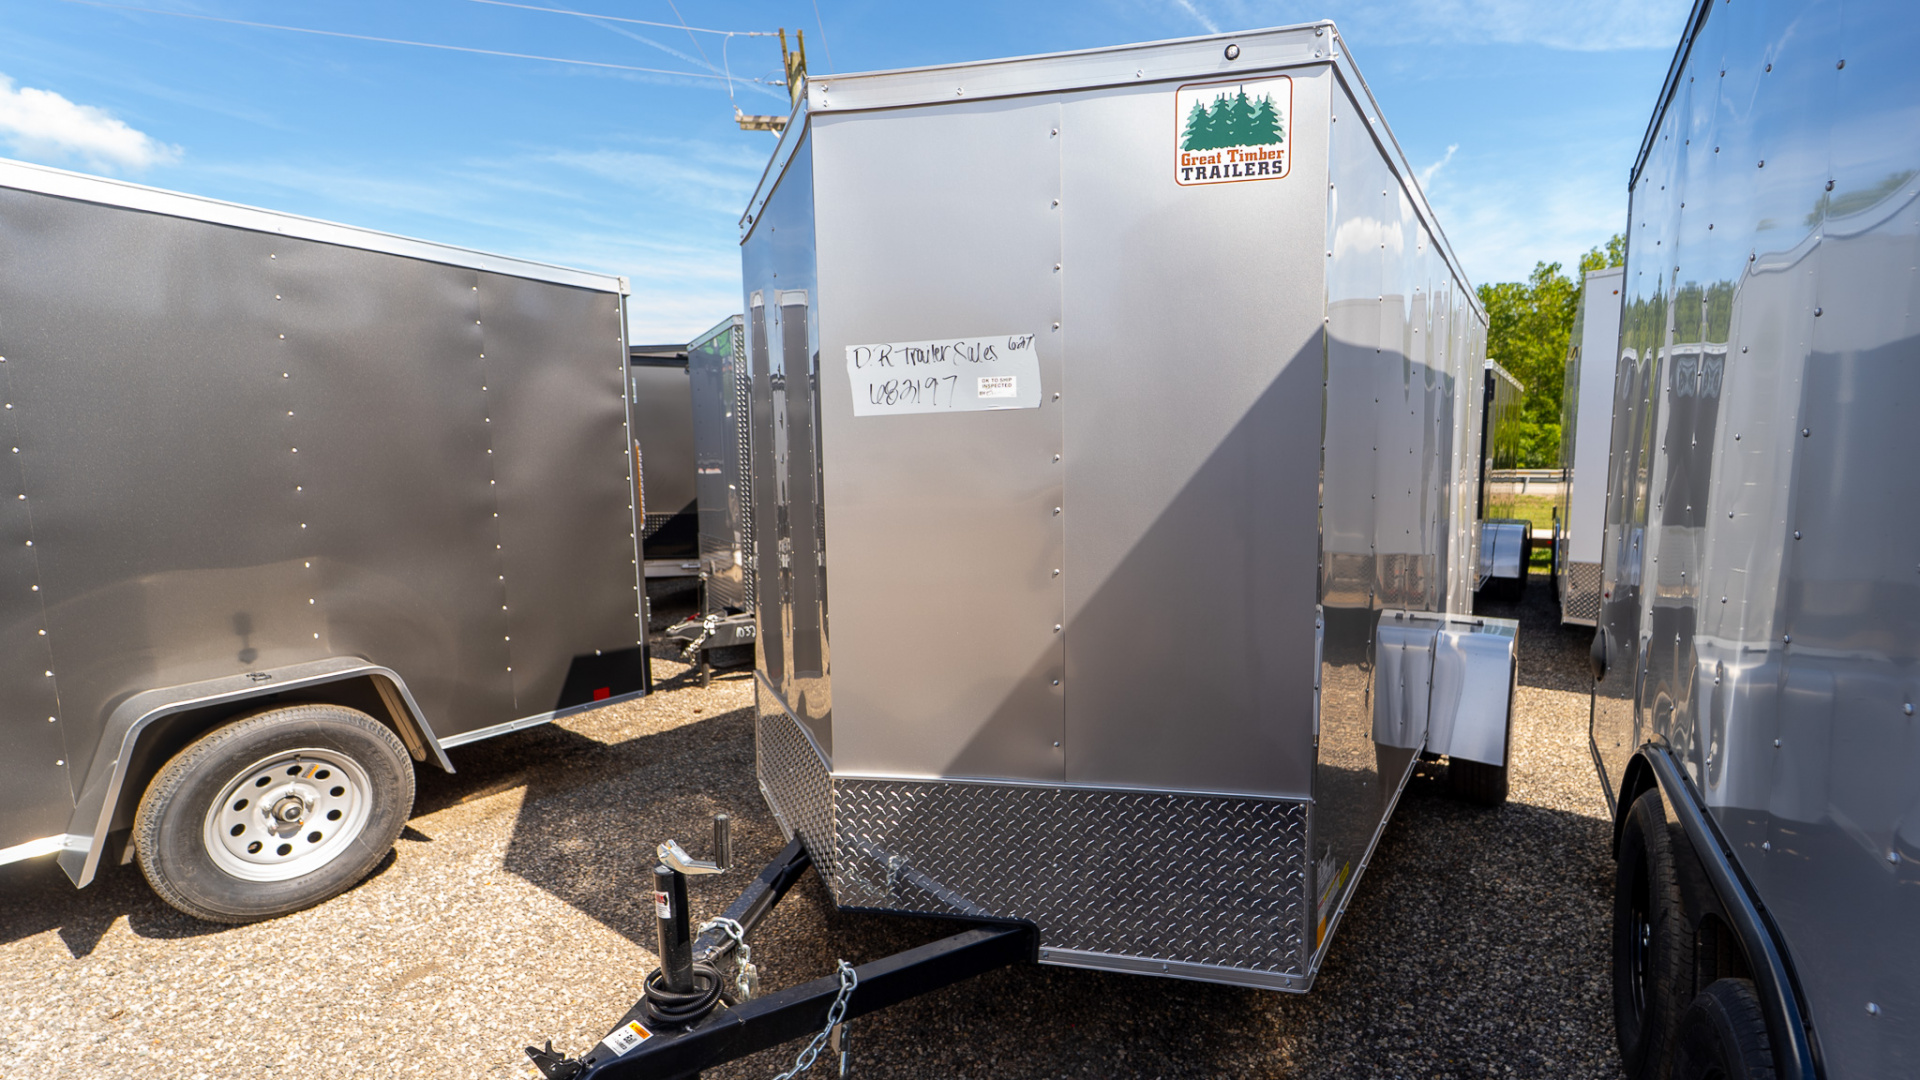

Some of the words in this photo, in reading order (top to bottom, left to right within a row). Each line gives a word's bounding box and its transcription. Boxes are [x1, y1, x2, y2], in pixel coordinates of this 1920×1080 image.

[1181, 152, 1222, 166] Great
[1227, 147, 1284, 163] Timber
[1181, 160, 1283, 181] TRAILERS
[895, 344, 950, 367] Trailer
[953, 341, 999, 366] Sales
